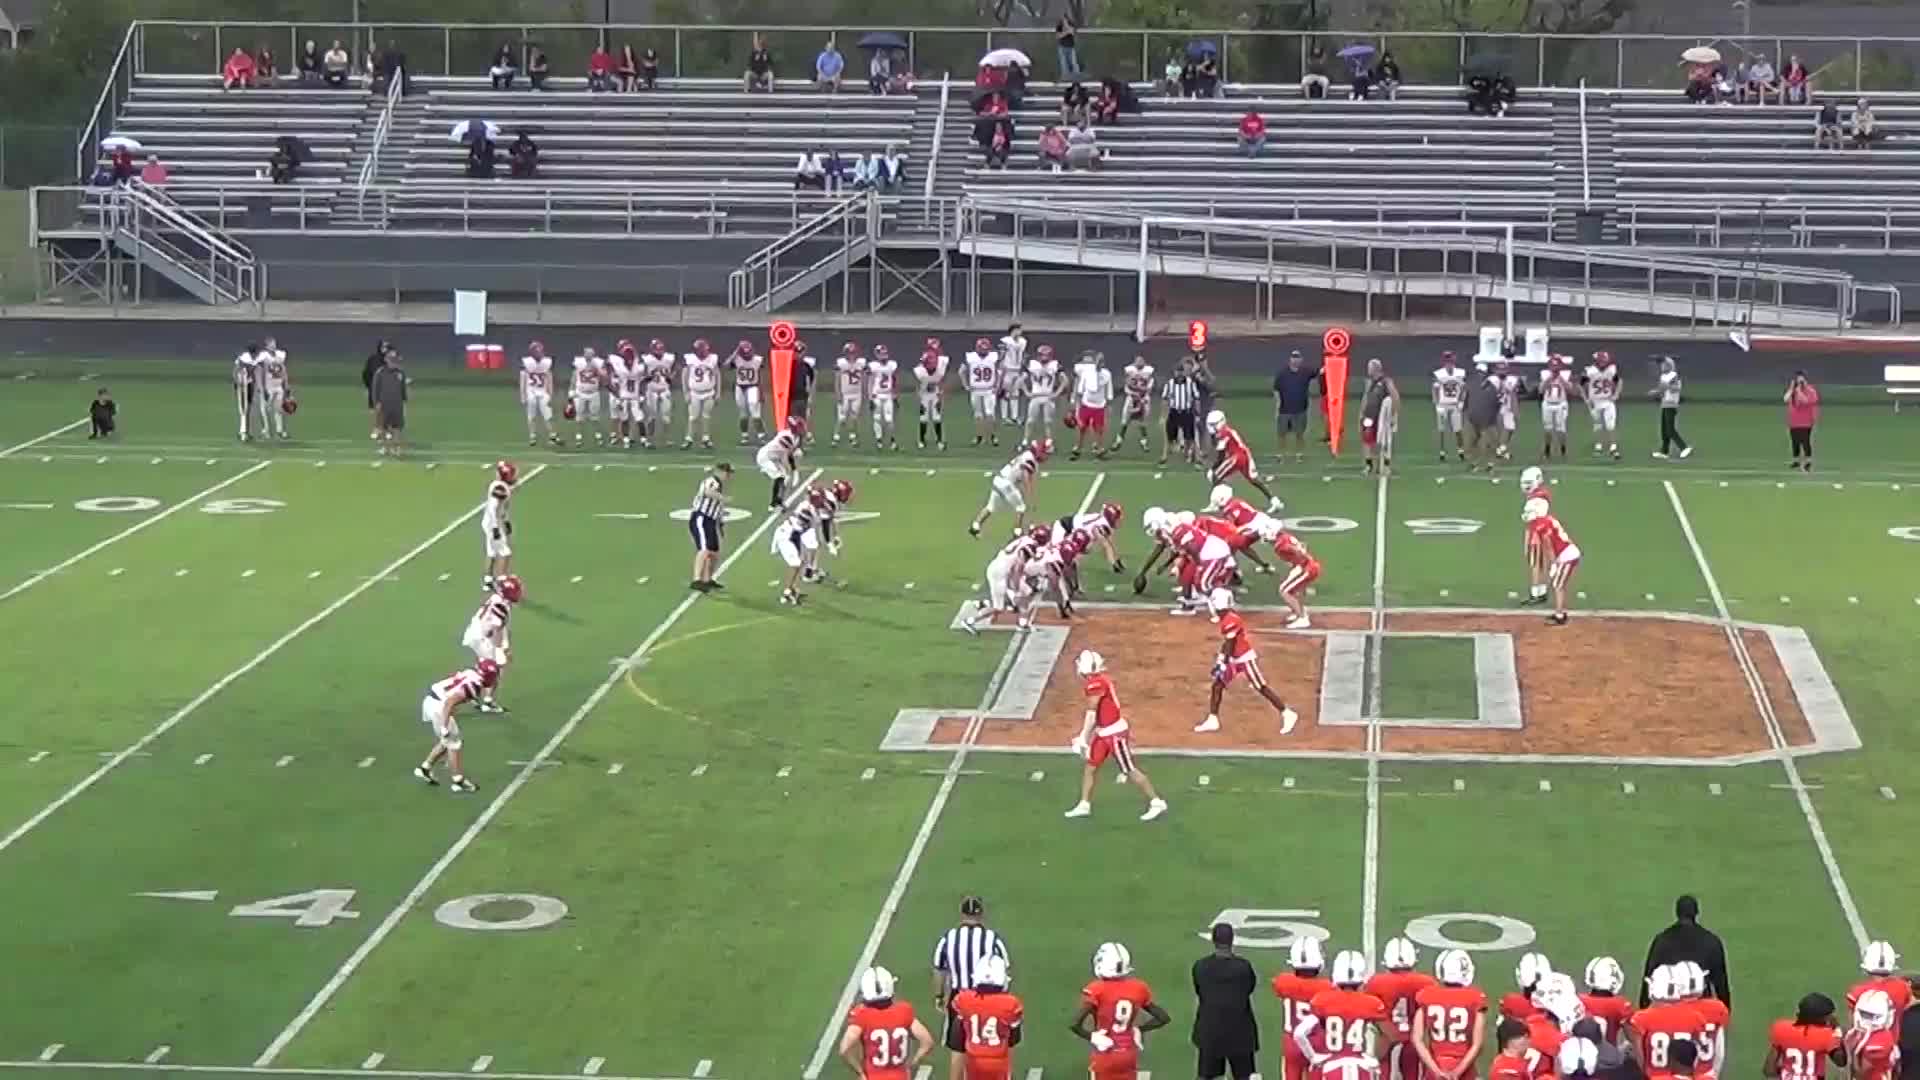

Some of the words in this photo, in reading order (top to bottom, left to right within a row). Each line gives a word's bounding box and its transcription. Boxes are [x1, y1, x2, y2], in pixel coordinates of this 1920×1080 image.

[1191, 321, 1206, 346] 3
[229, 888, 568, 930] 40
[1197, 908, 1536, 951] 50
[970, 1013, 1001, 1047] 14
[1114, 999, 1133, 1032] 9
[1325, 1015, 1365, 1053] 84
[1428, 1004, 1469, 1043] 32
[870, 1028, 910, 1067] 33
[1785, 1047, 1817, 1076] 31
